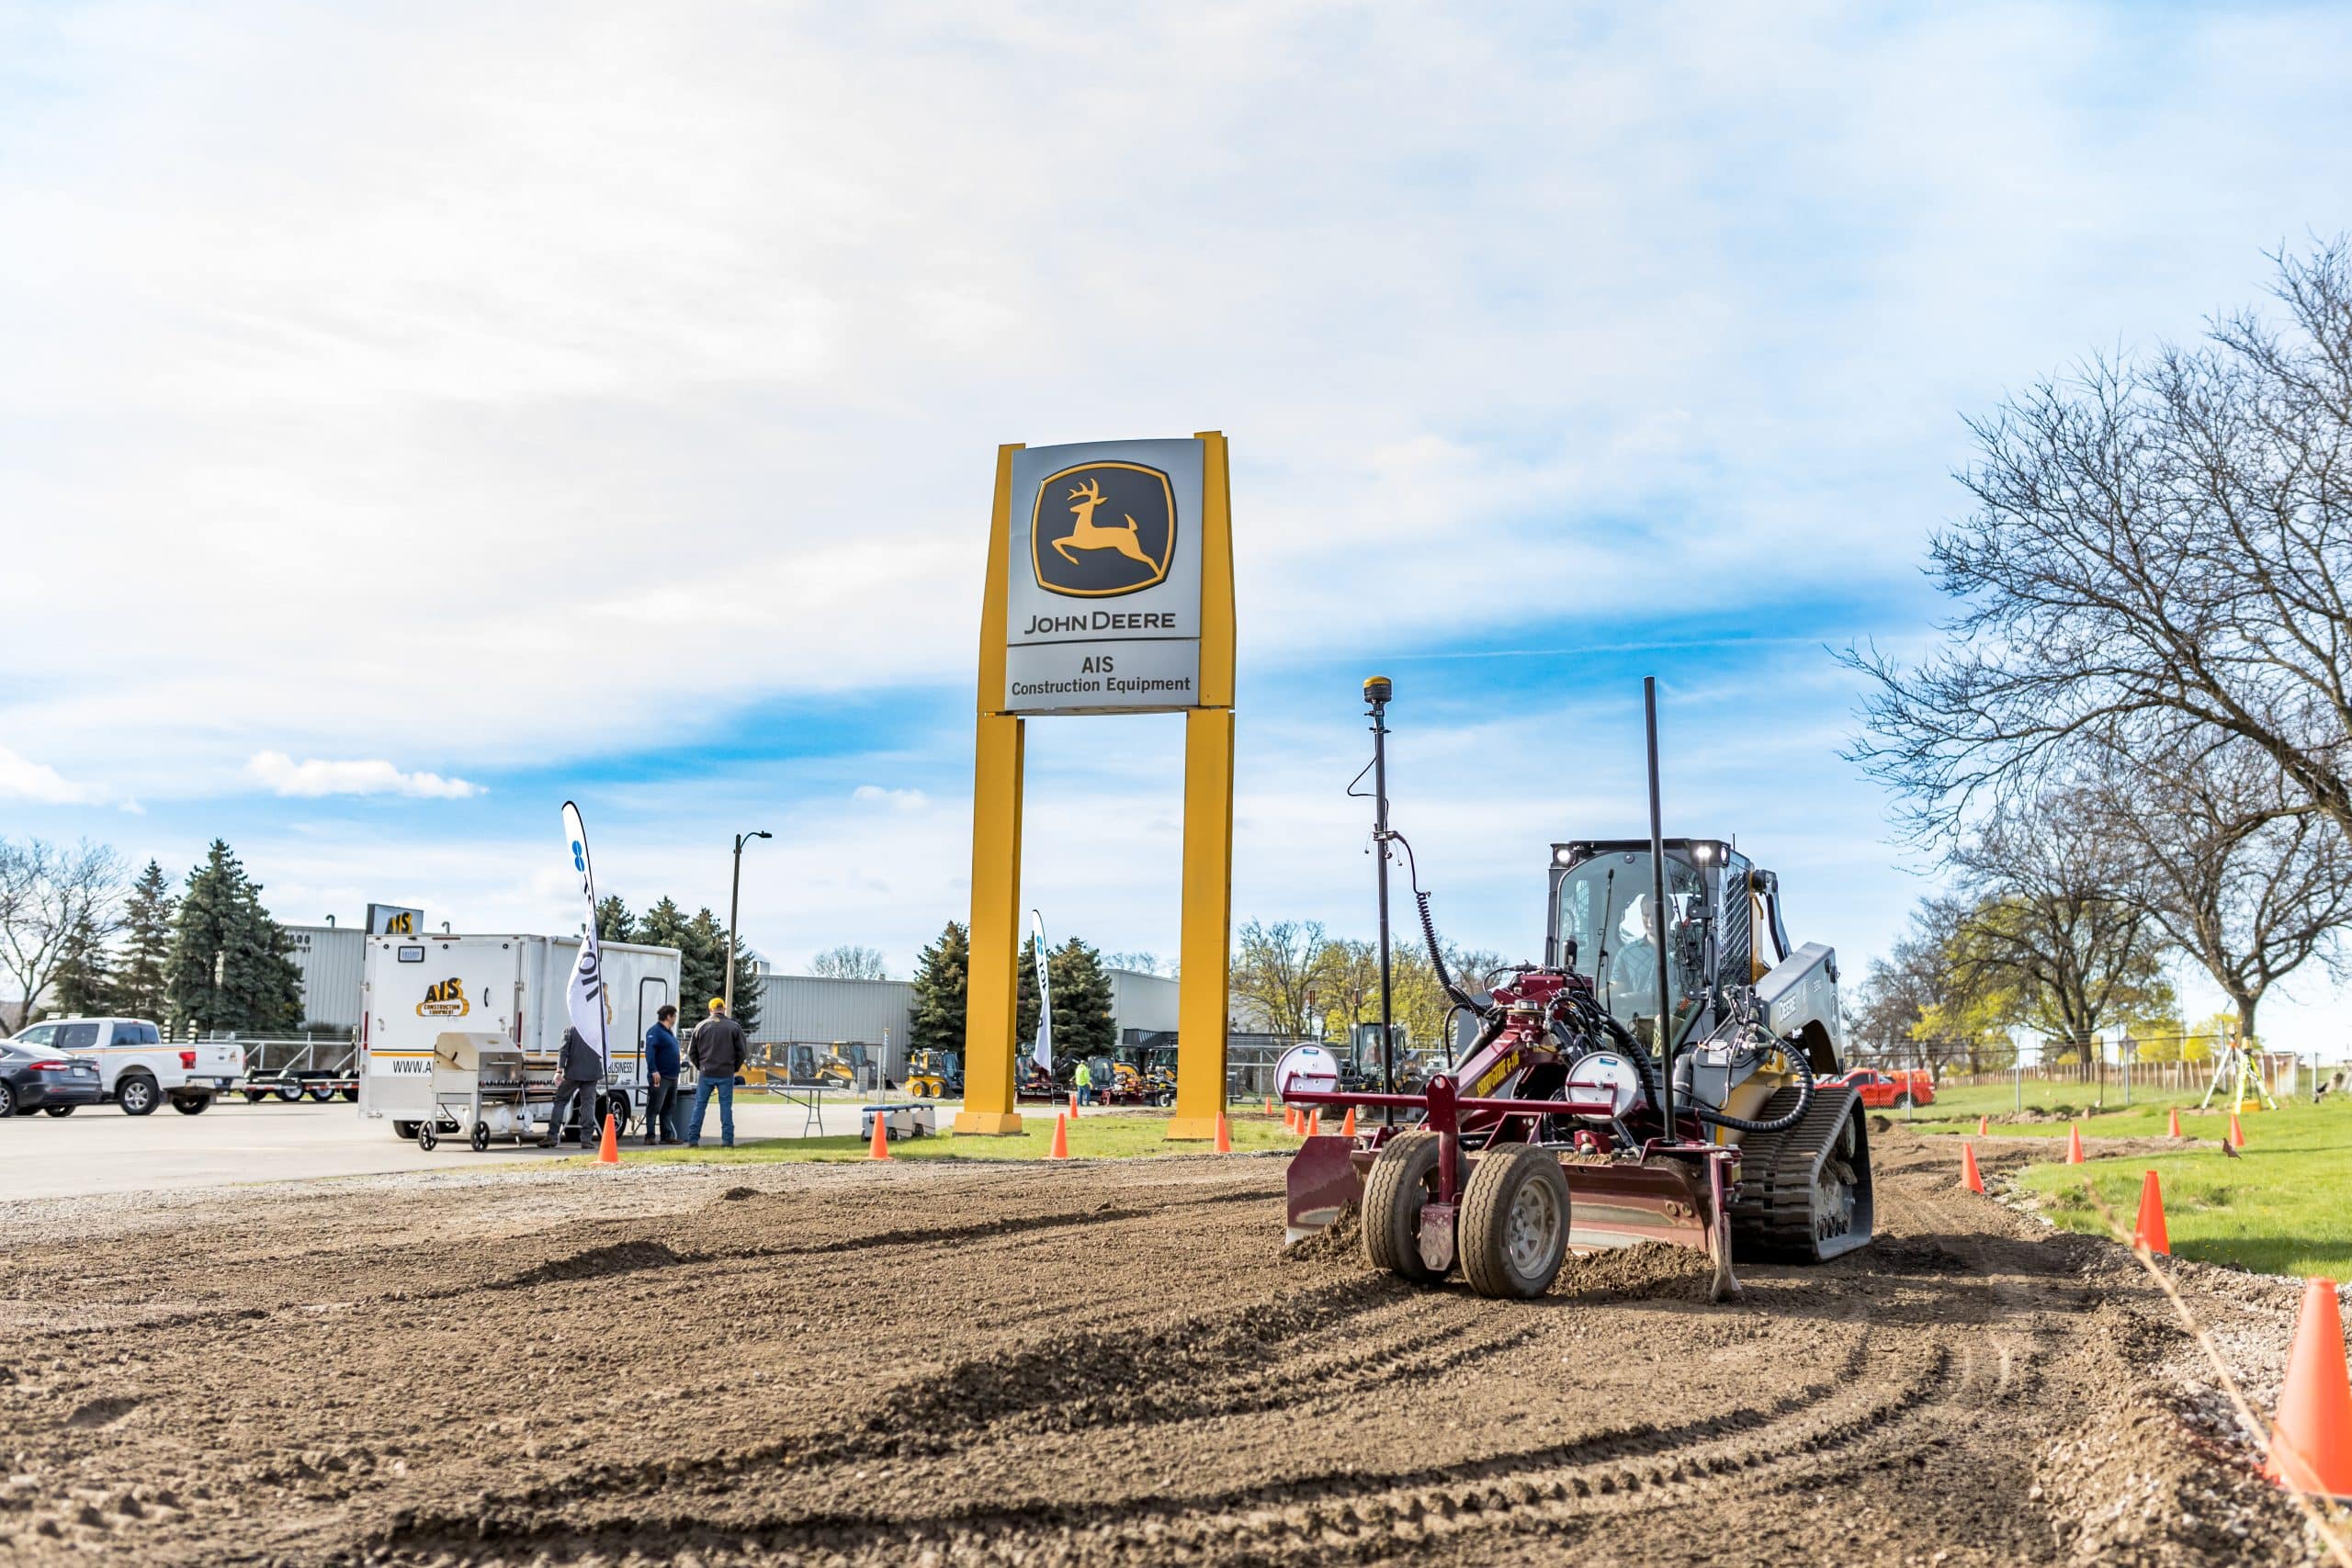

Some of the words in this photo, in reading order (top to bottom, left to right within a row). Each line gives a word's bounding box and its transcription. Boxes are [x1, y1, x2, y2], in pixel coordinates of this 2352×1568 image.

[1024, 615, 1088, 635] JOHN
[1091, 610, 1176, 630] DEERE
[1080, 655, 1114, 674] AIS
[1012, 678, 1101, 696] Construction
[1106, 676, 1191, 694] Equipment
[385, 911, 413, 934] AIS
[424, 976, 464, 1003] AIS
[1779, 995, 1796, 1022] DEERE
